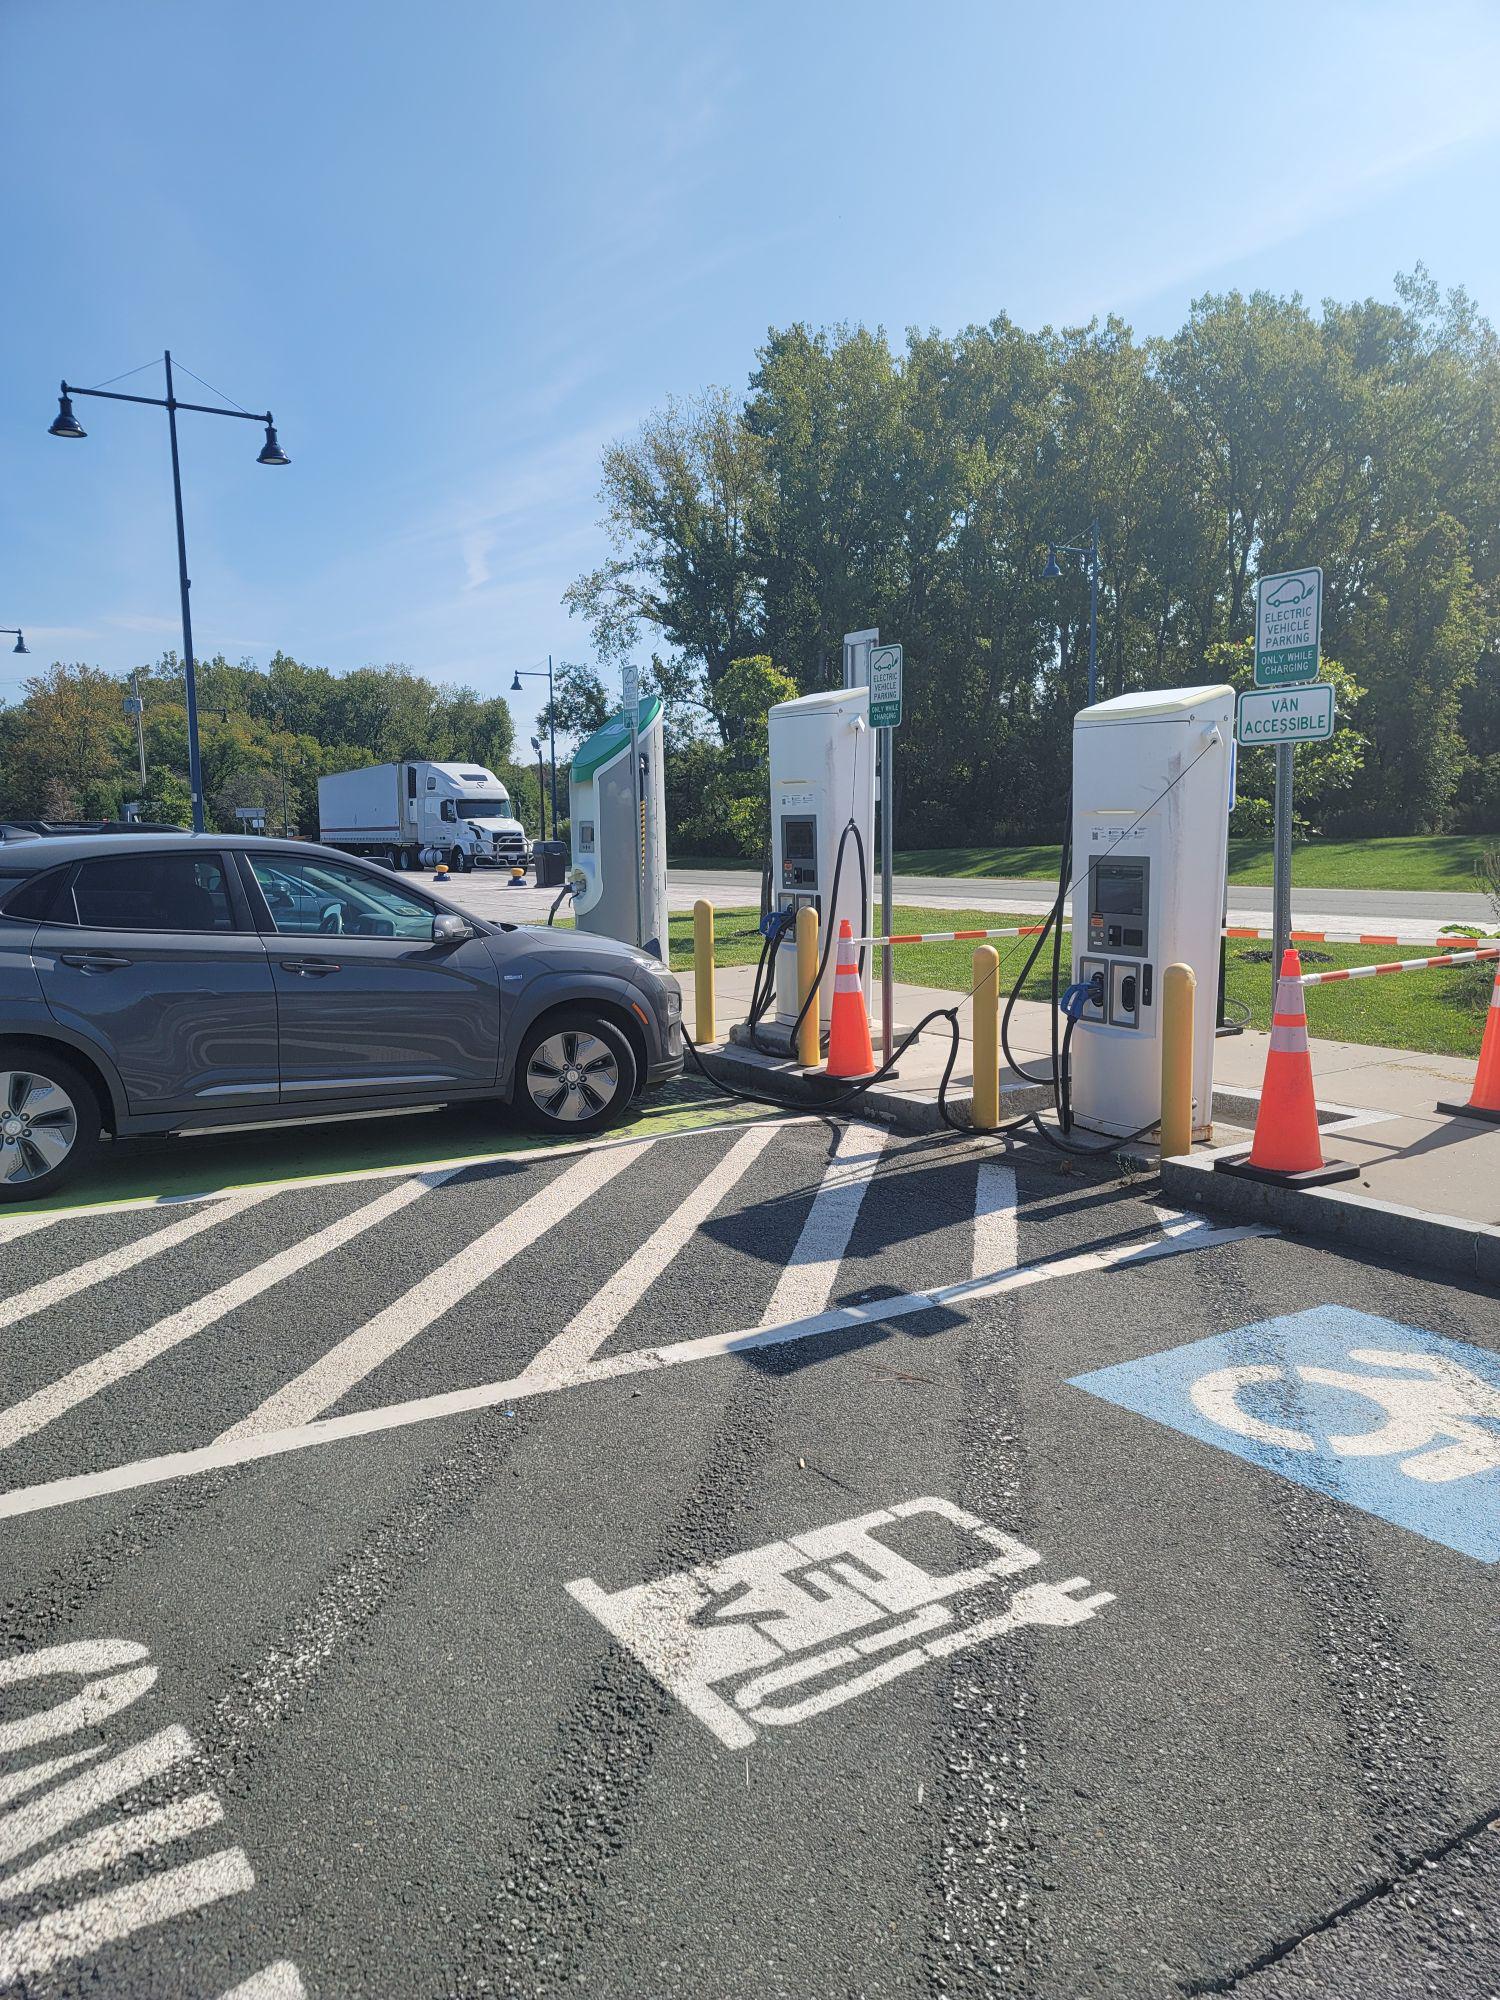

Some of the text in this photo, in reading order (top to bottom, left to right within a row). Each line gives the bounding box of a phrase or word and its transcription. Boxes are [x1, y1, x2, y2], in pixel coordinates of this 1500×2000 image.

[1265, 606, 1312, 624] ELECTRIC
[1267, 619, 1310, 636] VEHICLE
[1265, 632, 1310, 649] PARKING
[1261, 650, 1313, 666] ONLY WHILE
[1264, 661, 1309, 675] CHARGING
[873, 672, 898, 682] ELECTRIC
[874, 681, 897, 691] VEHICLE
[873, 690, 897, 701] PARKING
[1272, 697, 1299, 714] VAN
[873, 712, 897, 721] CHARGING
[1244, 714, 1326, 735] ACCESSIBLE
